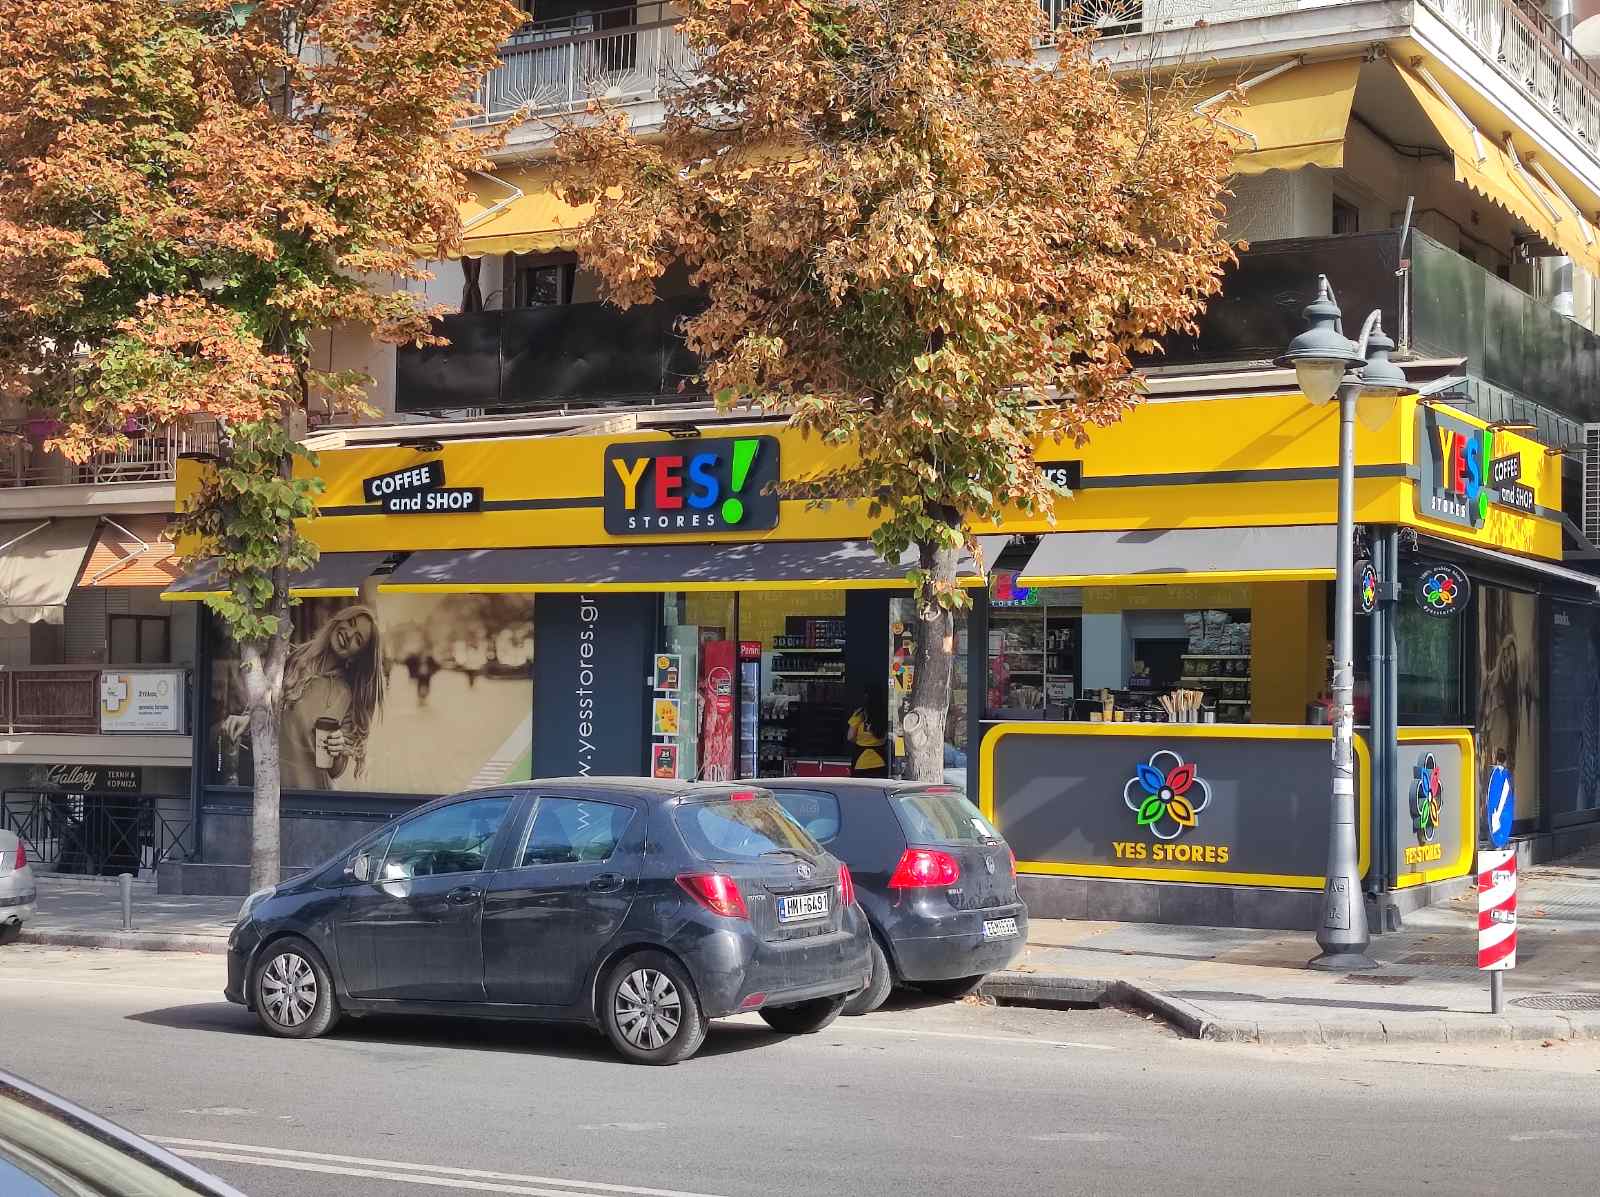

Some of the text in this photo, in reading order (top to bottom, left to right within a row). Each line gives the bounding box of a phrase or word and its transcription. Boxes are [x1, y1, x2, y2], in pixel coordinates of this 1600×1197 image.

[371, 465, 431, 496] COFFEE
[611, 439, 760, 524] YES!
[1438, 426, 1493, 520] YES!
[1494, 456, 1519, 482] COFFEE
[390, 491, 473, 511] and SHOP
[1431, 496, 1466, 518] STORES
[1501, 485, 1533, 510] and SHOP
[628, 513, 716, 529] STORES
[576, 595, 598, 831] ww.yesstores.gr
[47, 764, 97, 791] Gallery
[1112, 841, 1230, 865] YES STORES
[787, 895, 828, 915] HMI-6491
